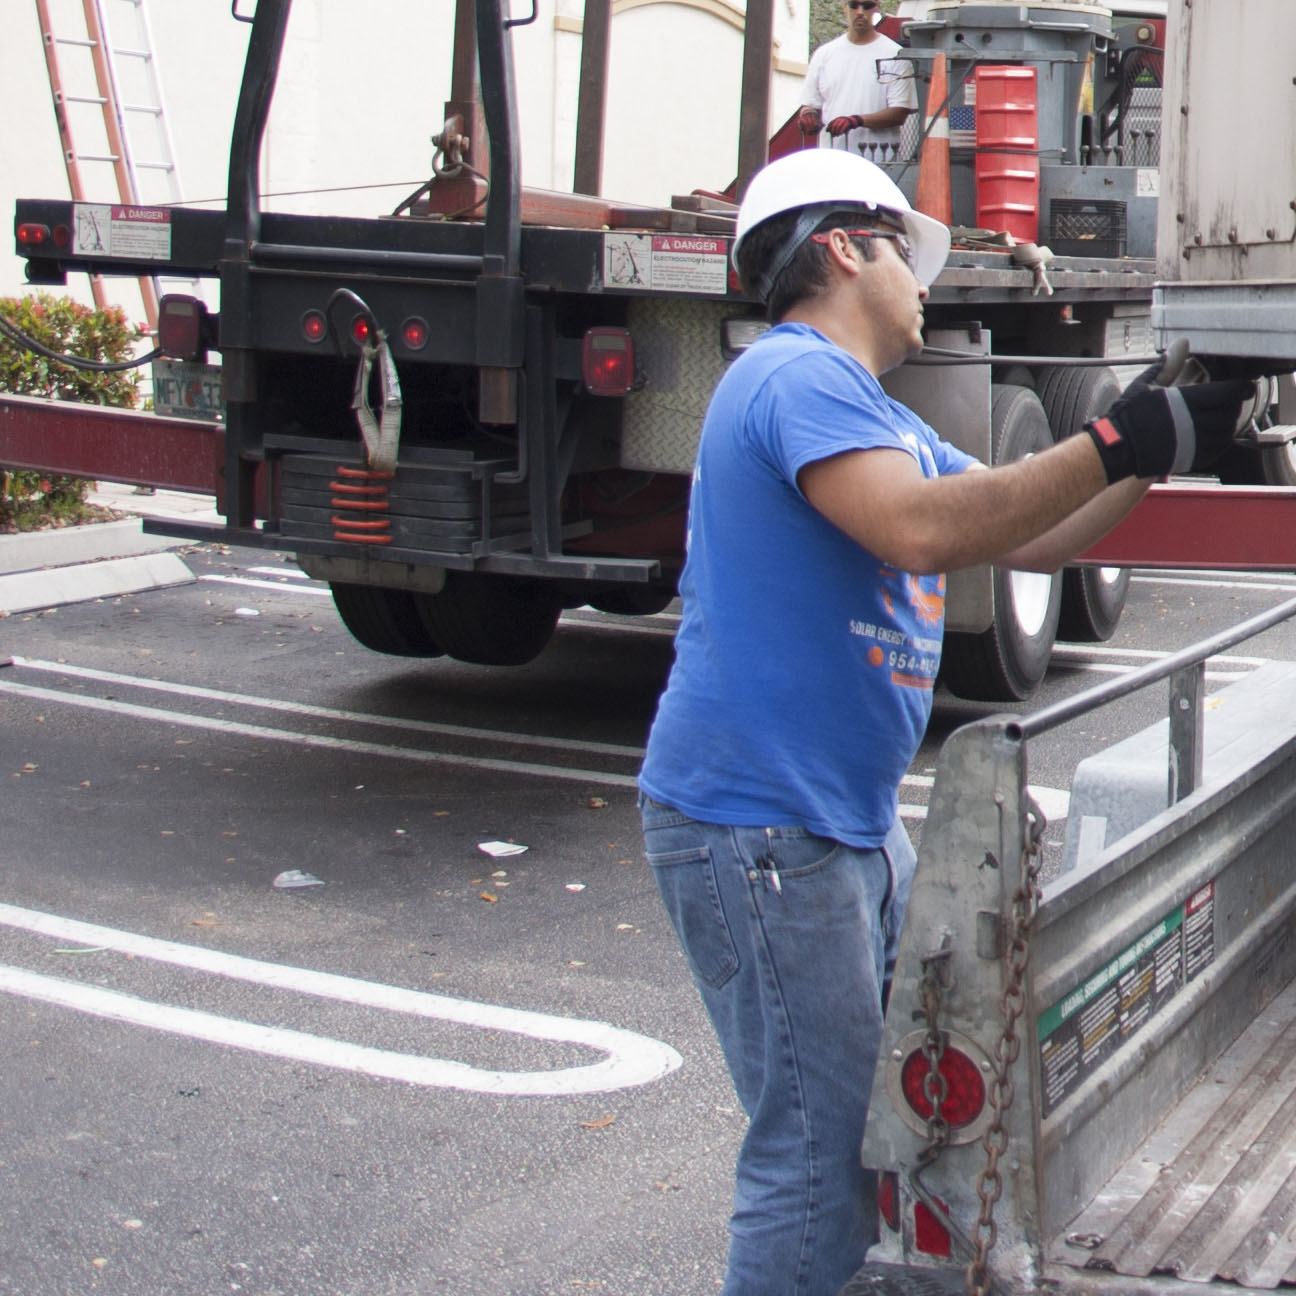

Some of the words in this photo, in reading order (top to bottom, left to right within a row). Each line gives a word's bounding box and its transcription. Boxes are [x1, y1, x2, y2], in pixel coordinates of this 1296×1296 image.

[128, 209, 164, 220] DANGER
[674, 240, 717, 251] DANGER
[850, 620, 876, 638] SOLAR
[878, 627, 906, 646] ENERGY
